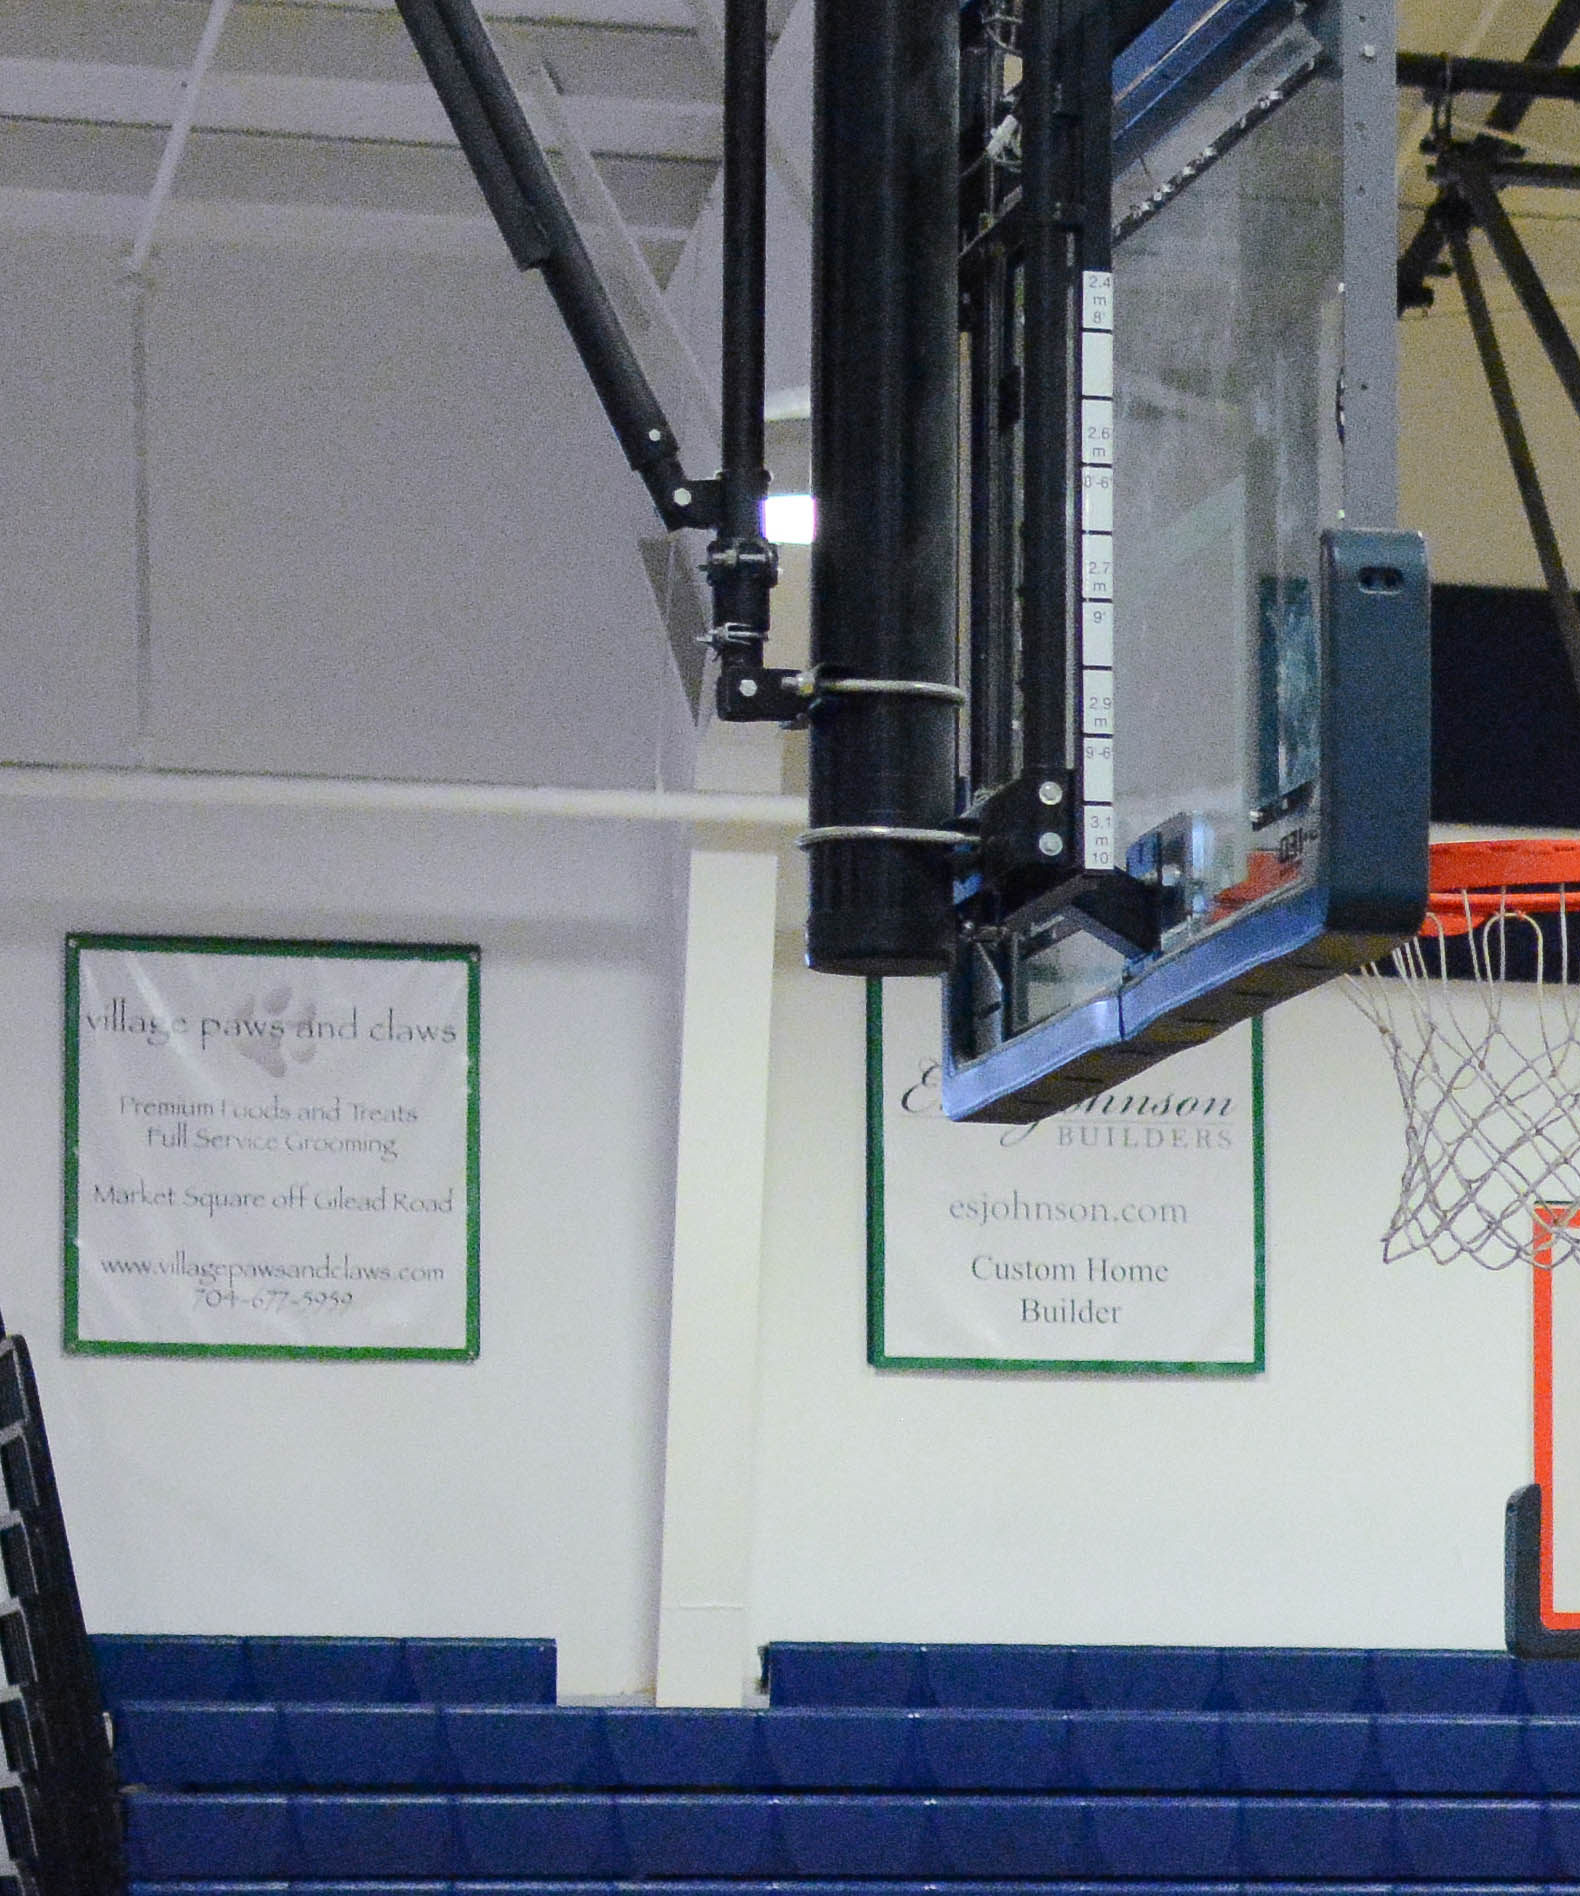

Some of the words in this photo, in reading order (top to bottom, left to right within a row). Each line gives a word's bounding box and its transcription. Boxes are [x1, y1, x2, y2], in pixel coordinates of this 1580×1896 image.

[1088, 275, 1111, 289] 2.4
[1092, 295, 1107, 306] m
[1087, 426, 1110, 440] 2.6
[1092, 446, 1106, 457] m
[1088, 561, 1110, 575] 2.7
[1092, 581, 1107, 592] m
[1093, 717, 1108, 728] m
[1089, 815, 1112, 829] 3.1
[1095, 836, 1109, 846] m
[86, 997, 189, 1047] village
[200, 1012, 286, 1051] paws
[295, 1007, 358, 1041] and
[369, 1006, 458, 1045] claws
[119, 1095, 214, 1119] Premium
[299, 1097, 341, 1123] and
[348, 1101, 419, 1126] Treats
[146, 1121, 188, 1150] Full
[195, 1128, 281, 1151] Service
[285, 1131, 400, 1163] Grooming
[1058, 1124, 1233, 1151] BUILDERS
[93, 1176, 174, 1207] Market
[184, 1184, 266, 1218] Square
[271, 1182, 308, 1209] off
[313, 1184, 387, 1212] Gilead
[392, 1187, 454, 1214] Road
[948, 1189, 1188, 1226] esjohnson.com
[99, 1249, 446, 1288] www.villagepawsandclaws.com
[970, 1254, 1076, 1284] Custom
[1087, 1257, 1169, 1284] Home
[1020, 1297, 1124, 1325] Builder
